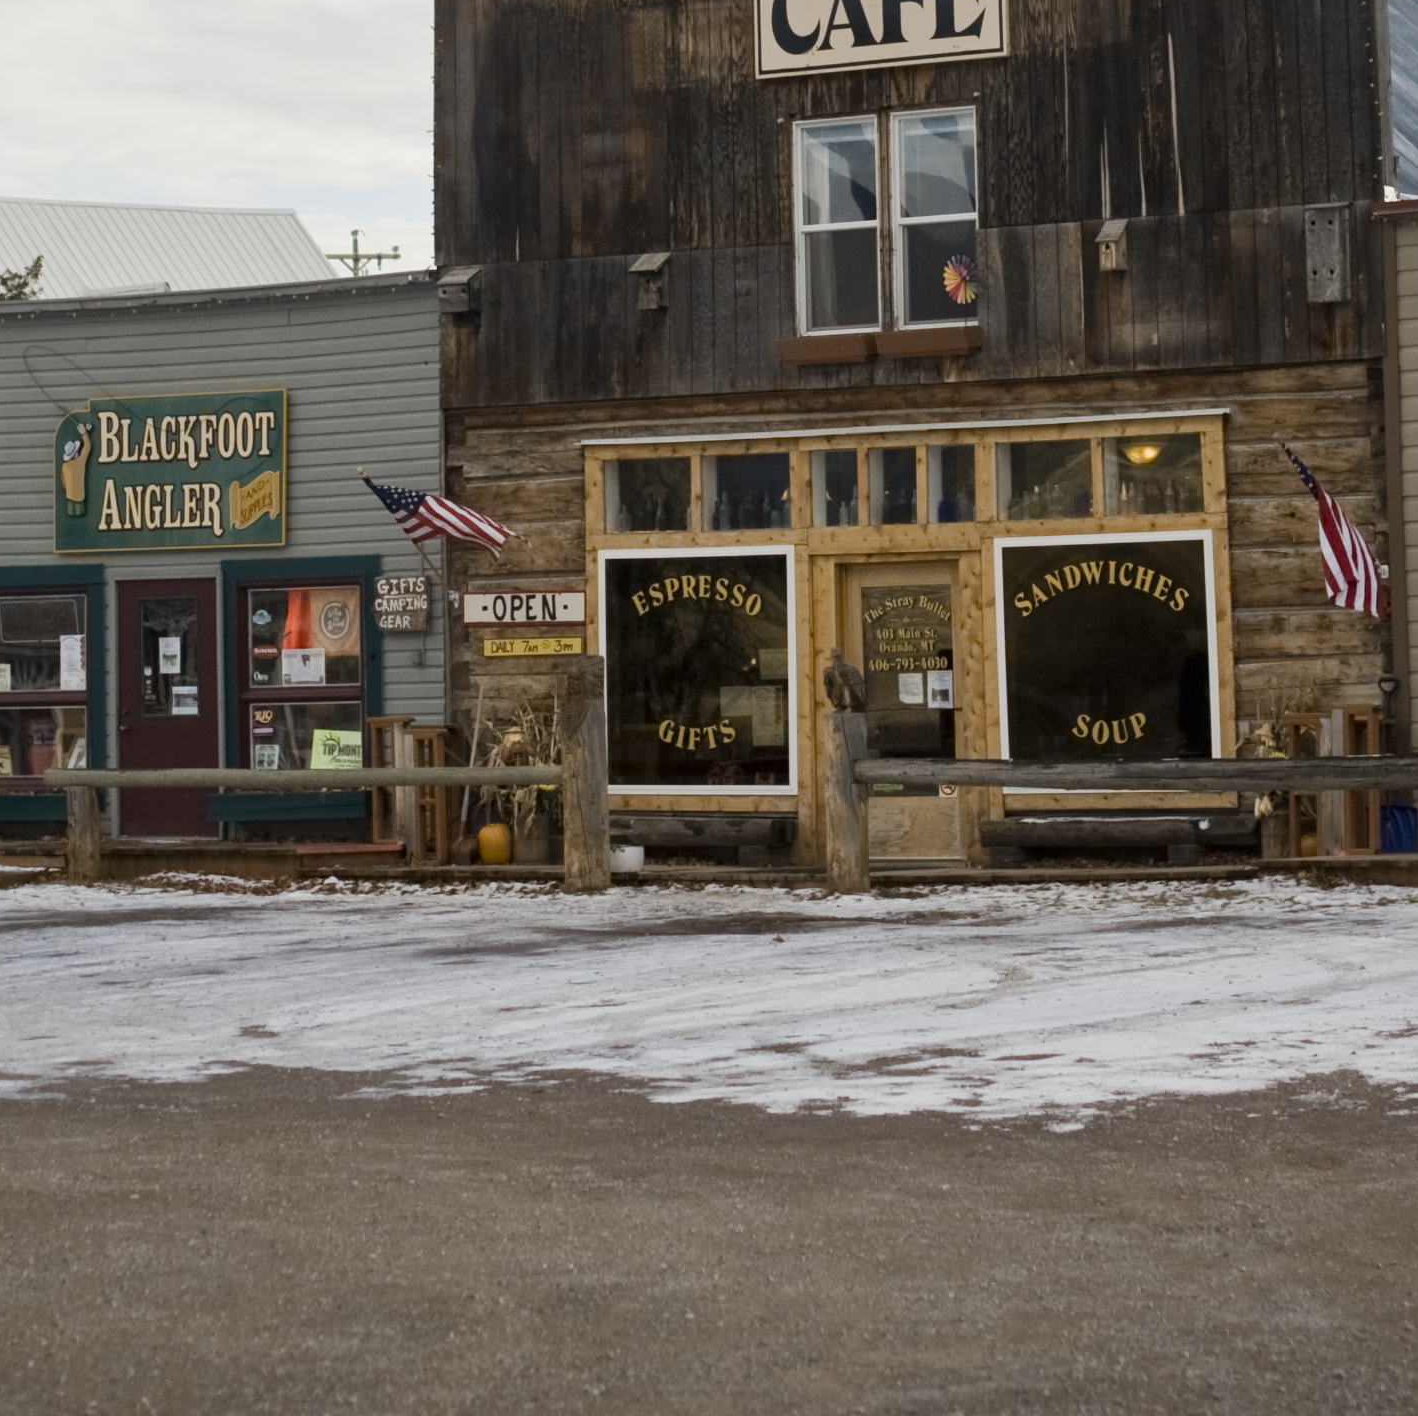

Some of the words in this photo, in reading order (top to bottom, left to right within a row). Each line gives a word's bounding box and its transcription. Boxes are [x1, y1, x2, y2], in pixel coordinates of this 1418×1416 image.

[97, 411, 275, 469] BLACKFOOT
[97, 478, 224, 537] ANGLER
[241, 492, 273, 523] SUPPLIES
[377, 577, 426, 595] GIFTS
[631, 575, 762, 617] ESPRESSO
[1014, 560, 1190, 618] SANDWICHES
[374, 595, 428, 612] CAMPING
[493, 594, 557, 621] OPEN
[863, 606, 885, 624] The
[884, 596, 916, 611] Stray
[919, 595, 951, 622] Bullet
[380, 615, 412, 629] GEAR
[876, 629, 894, 640] 403
[898, 628, 921, 639] Main
[924, 627, 938, 639] St.
[490, 641, 515, 654] DAILY
[879, 642, 917, 653] Ovando,
[921, 640, 935, 651] MT
[868, 656, 948, 671] 406-793-4030
[658, 719, 736, 750] GIFTS
[1071, 712, 1147, 745] SOUP
